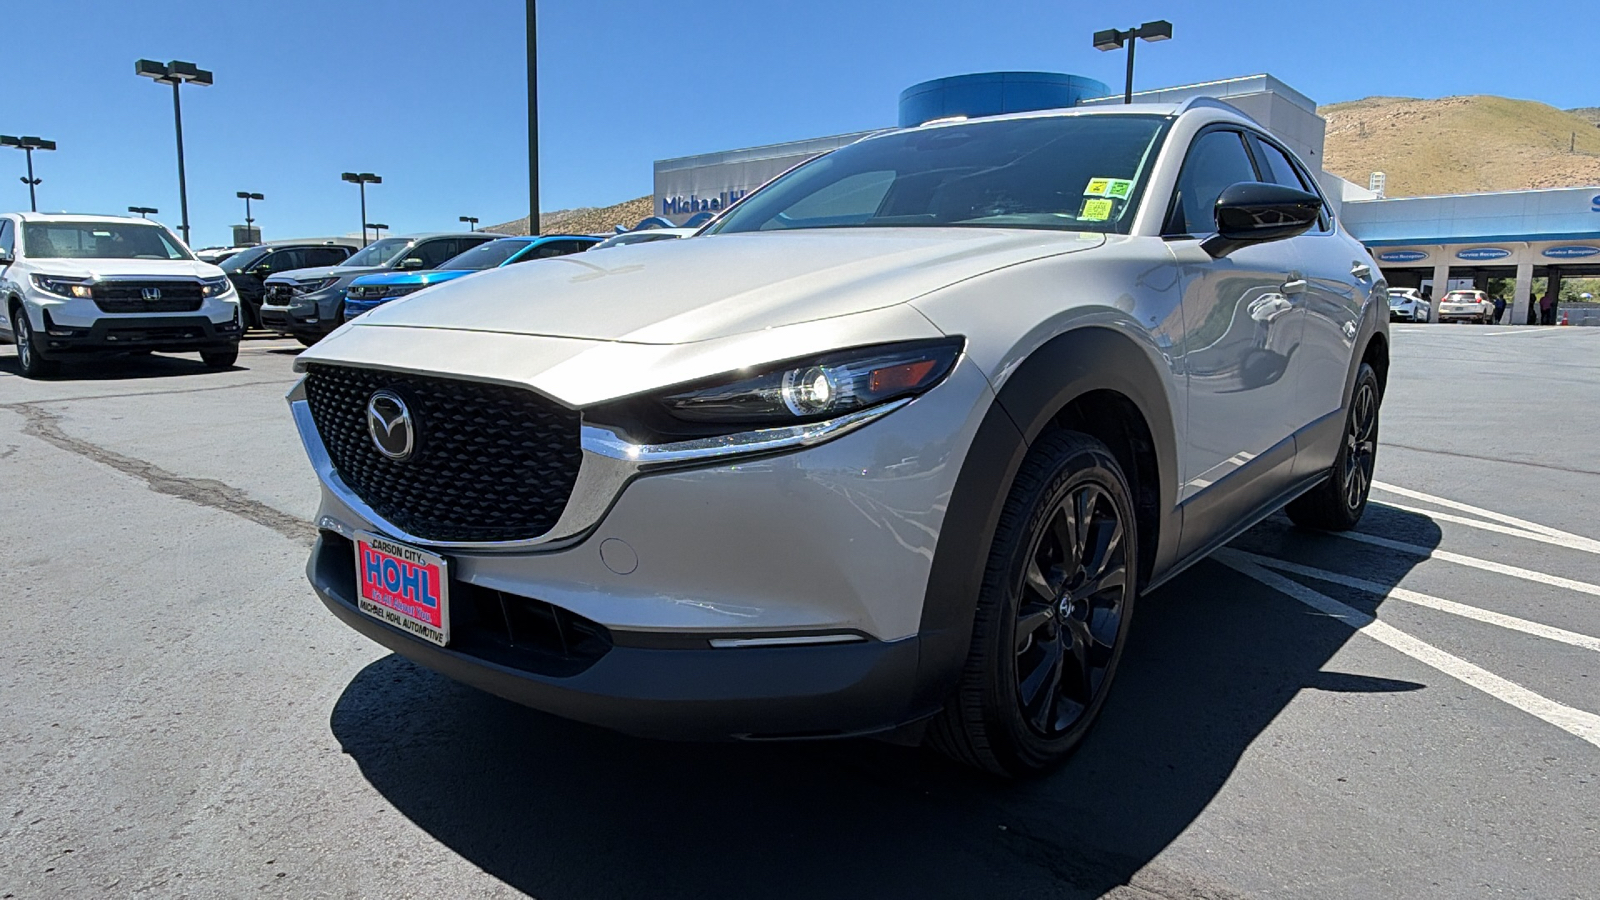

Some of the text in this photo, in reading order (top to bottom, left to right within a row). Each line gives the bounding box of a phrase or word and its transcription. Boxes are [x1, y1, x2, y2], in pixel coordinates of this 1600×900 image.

[663, 191, 725, 214] Michael
[372, 539, 422, 562] CARSON CITY
[365, 550, 437, 609] HOHL
[360, 600, 444, 643] MICHAEL HOHL AUTOMOTIVE
